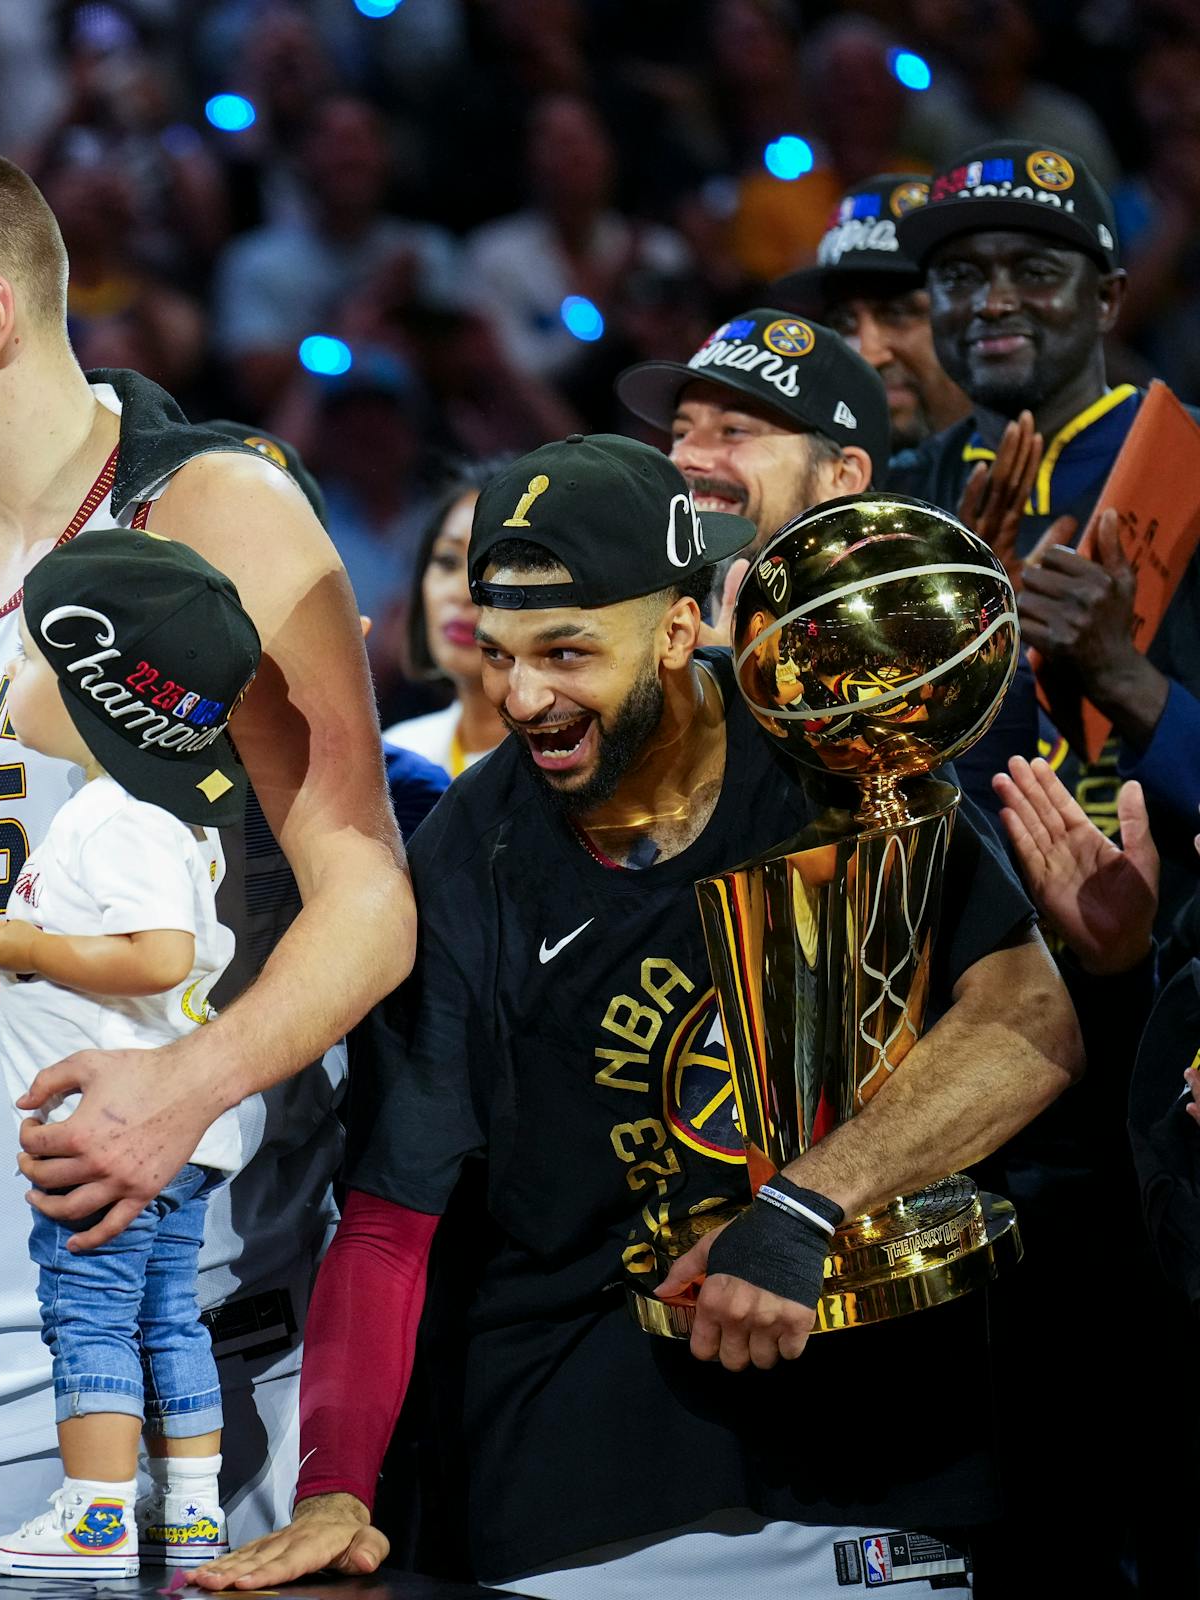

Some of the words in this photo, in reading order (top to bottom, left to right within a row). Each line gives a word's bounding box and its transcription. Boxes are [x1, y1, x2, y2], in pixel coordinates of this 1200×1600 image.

[125, 660, 186, 711] 22-23
[594, 957, 696, 1093] NBA
[880, 1238, 911, 1267] THE
[893, 1546, 905, 1556] 52
